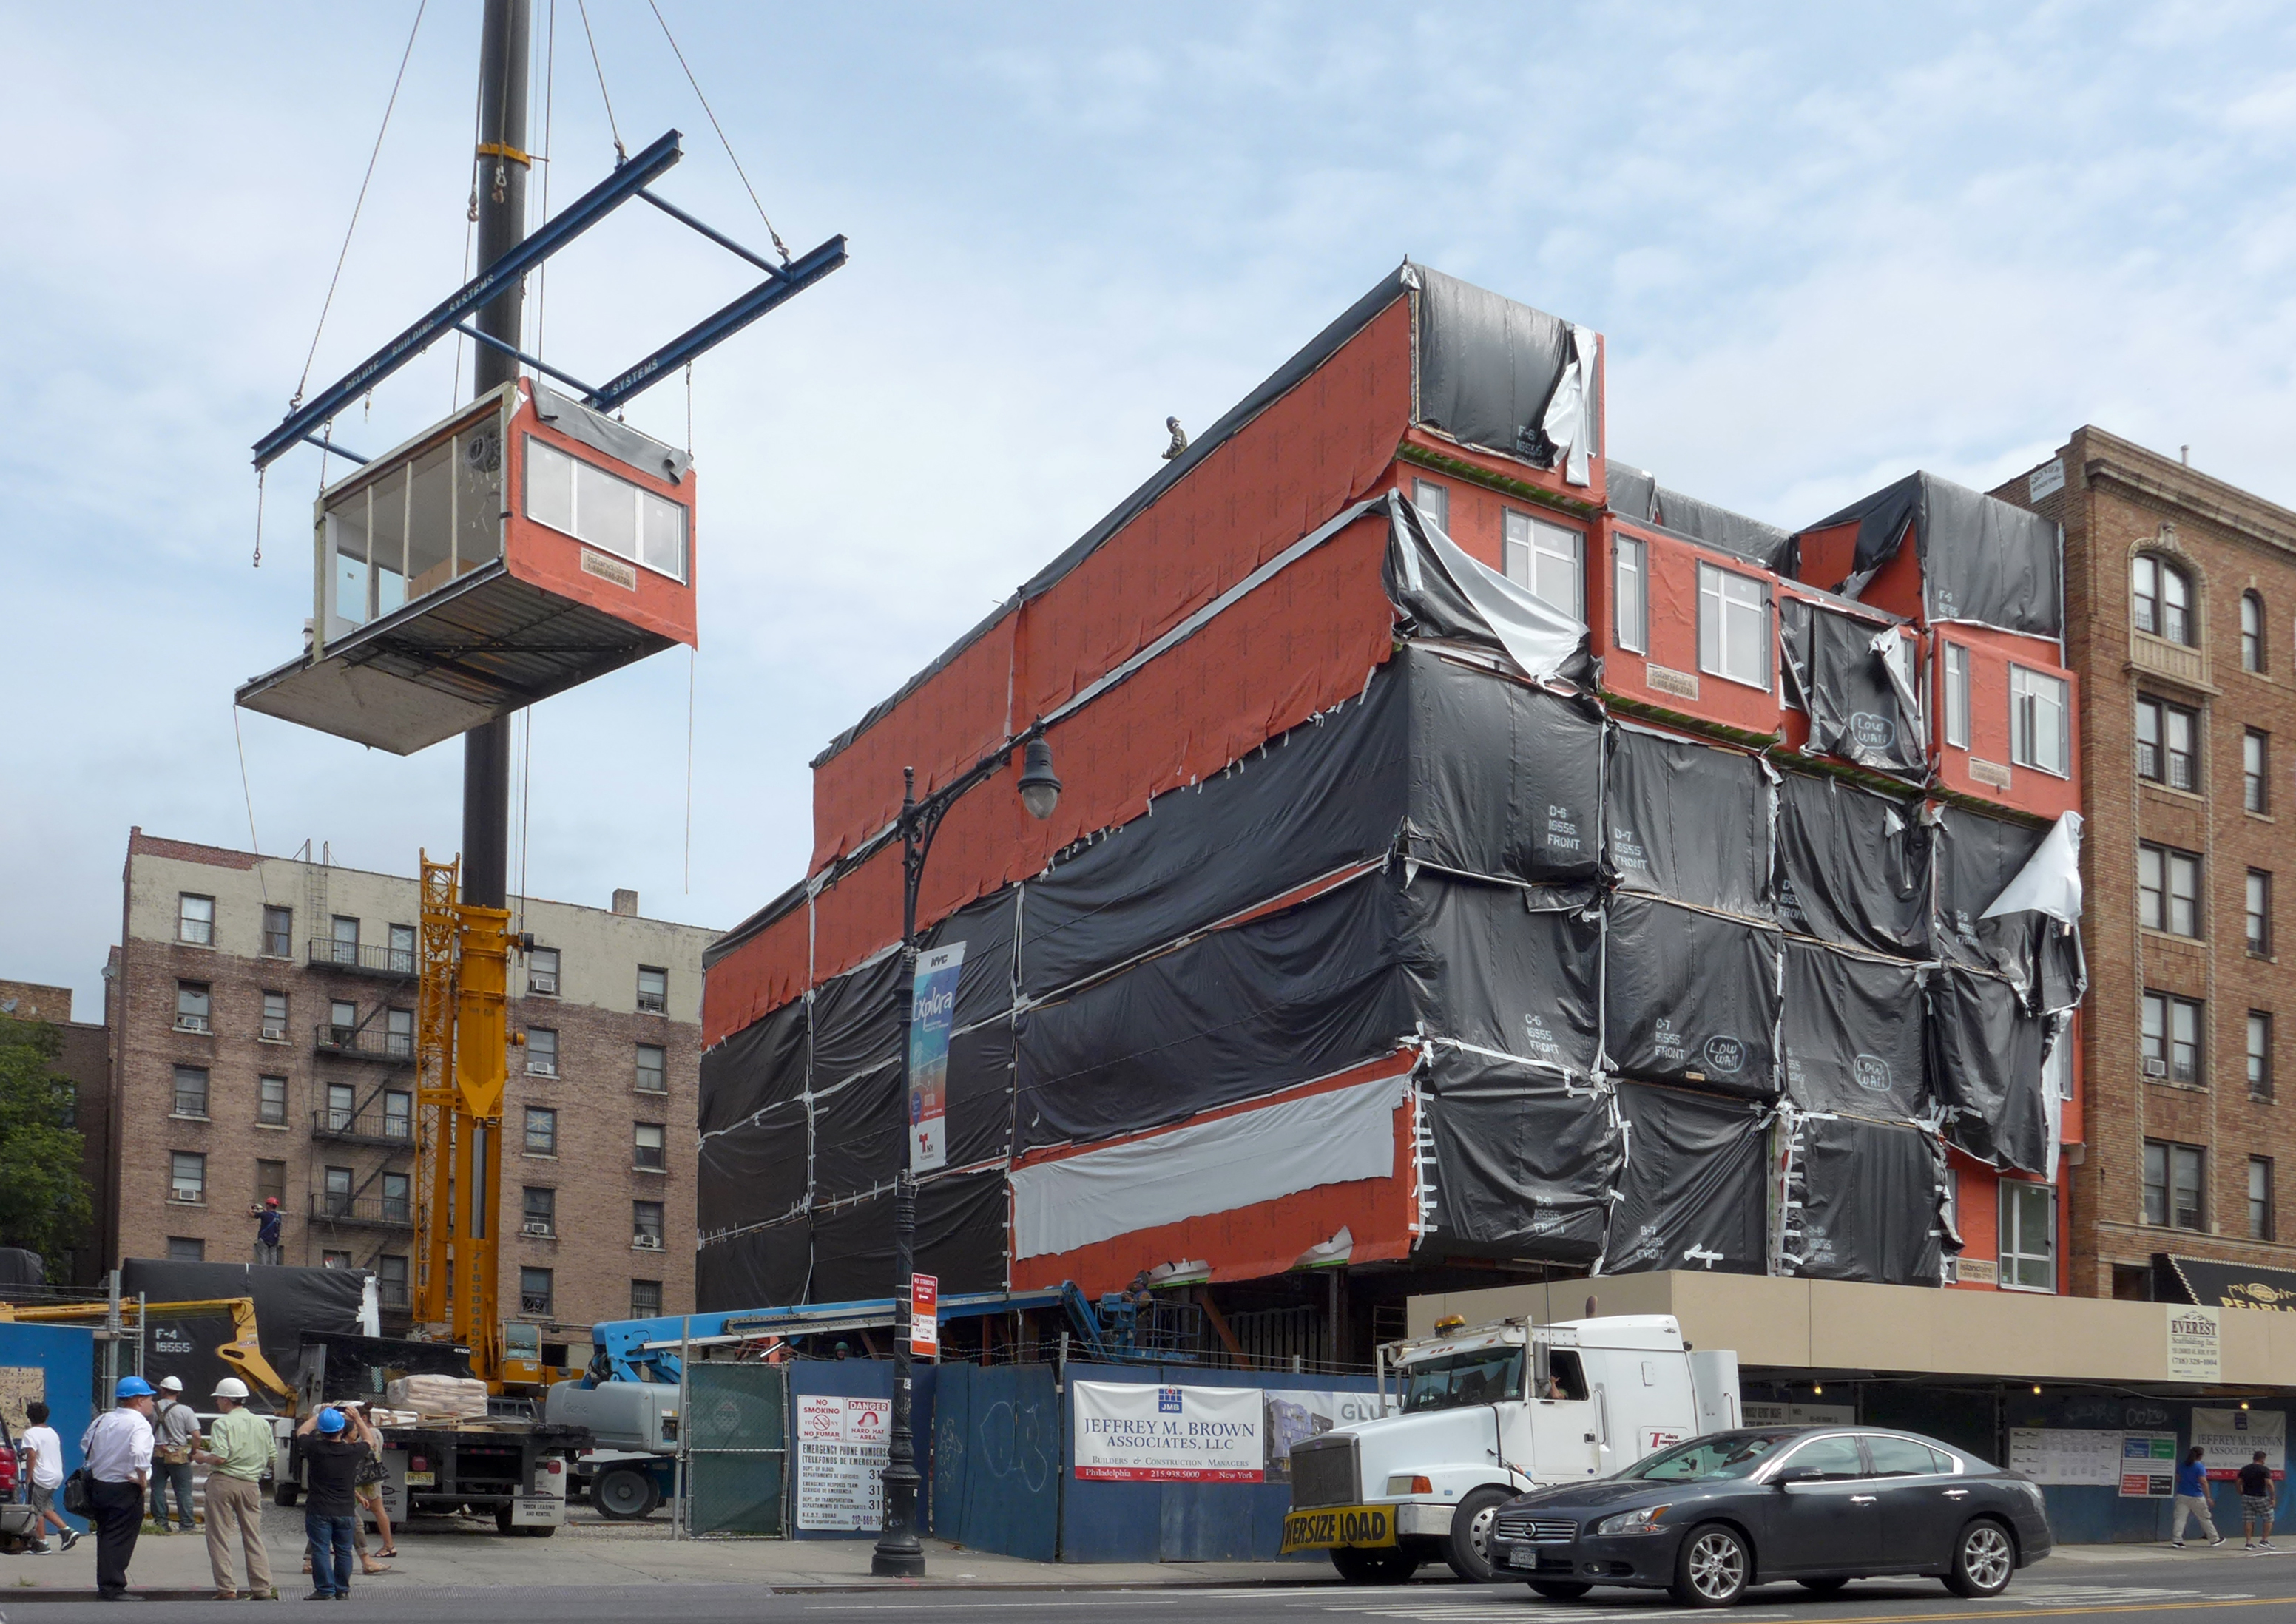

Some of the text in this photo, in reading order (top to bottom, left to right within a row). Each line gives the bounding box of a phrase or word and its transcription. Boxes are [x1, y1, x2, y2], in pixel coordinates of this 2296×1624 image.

[448, 274, 495, 314] SYSTEMS
[612, 359, 658, 396] SYSTEMS
[1518, 425, 1536, 441] F-6
[1857, 717, 1884, 732] LOW
[1549, 804, 1567, 819] D-6
[1548, 819, 1576, 835] 16555
[1547, 833, 1581, 850] FRONT
[1614, 828, 1633, 842] D-7
[1615, 840, 1642, 856] 16555
[1615, 854, 1648, 870] FRONT
[931, 953, 948, 968] NYC
[912, 987, 953, 1031] Explora
[1525, 1013, 1542, 1026] C-6
[1656, 1018, 1672, 1031] C-7
[1526, 1026, 1553, 1041] 16555
[1529, 1039, 1559, 1055] FRONT
[1655, 1045, 1685, 1060] FRONT
[1709, 1041, 1738, 1055] LOW
[1857, 1058, 1884, 1075] LOW
[1640, 1225, 1657, 1236] B-7
[155, 1328, 178, 1340] F-4
[2171, 1319, 2217, 1336] EVEREST
[803, 1407, 840, 1415] SMOKING
[849, 1401, 888, 1412] DANGER
[1161, 1403, 1180, 1412] JMB
[1084, 1418, 1255, 1438] JEFFREY M. BROWN
[1106, 1435, 1235, 1451] ASSOCIATES, LLC
[2198, 1434, 2283, 1447] JEFFREY M. BROWN
[803, 1444, 837, 1455] EMERGENCY
[839, 1445, 858, 1456] PHONE
[802, 1455, 837, 1465] (TELEFONOS
[839, 1457, 847, 1465] DE
[1085, 1469, 1255, 1480] Philadelphia 215.938.5000 New York
[868, 1485, 884, 1495] 31
[868, 1500, 884, 1511] 31
[1285, 1511, 1387, 1547] OVERSIZE LOAD
